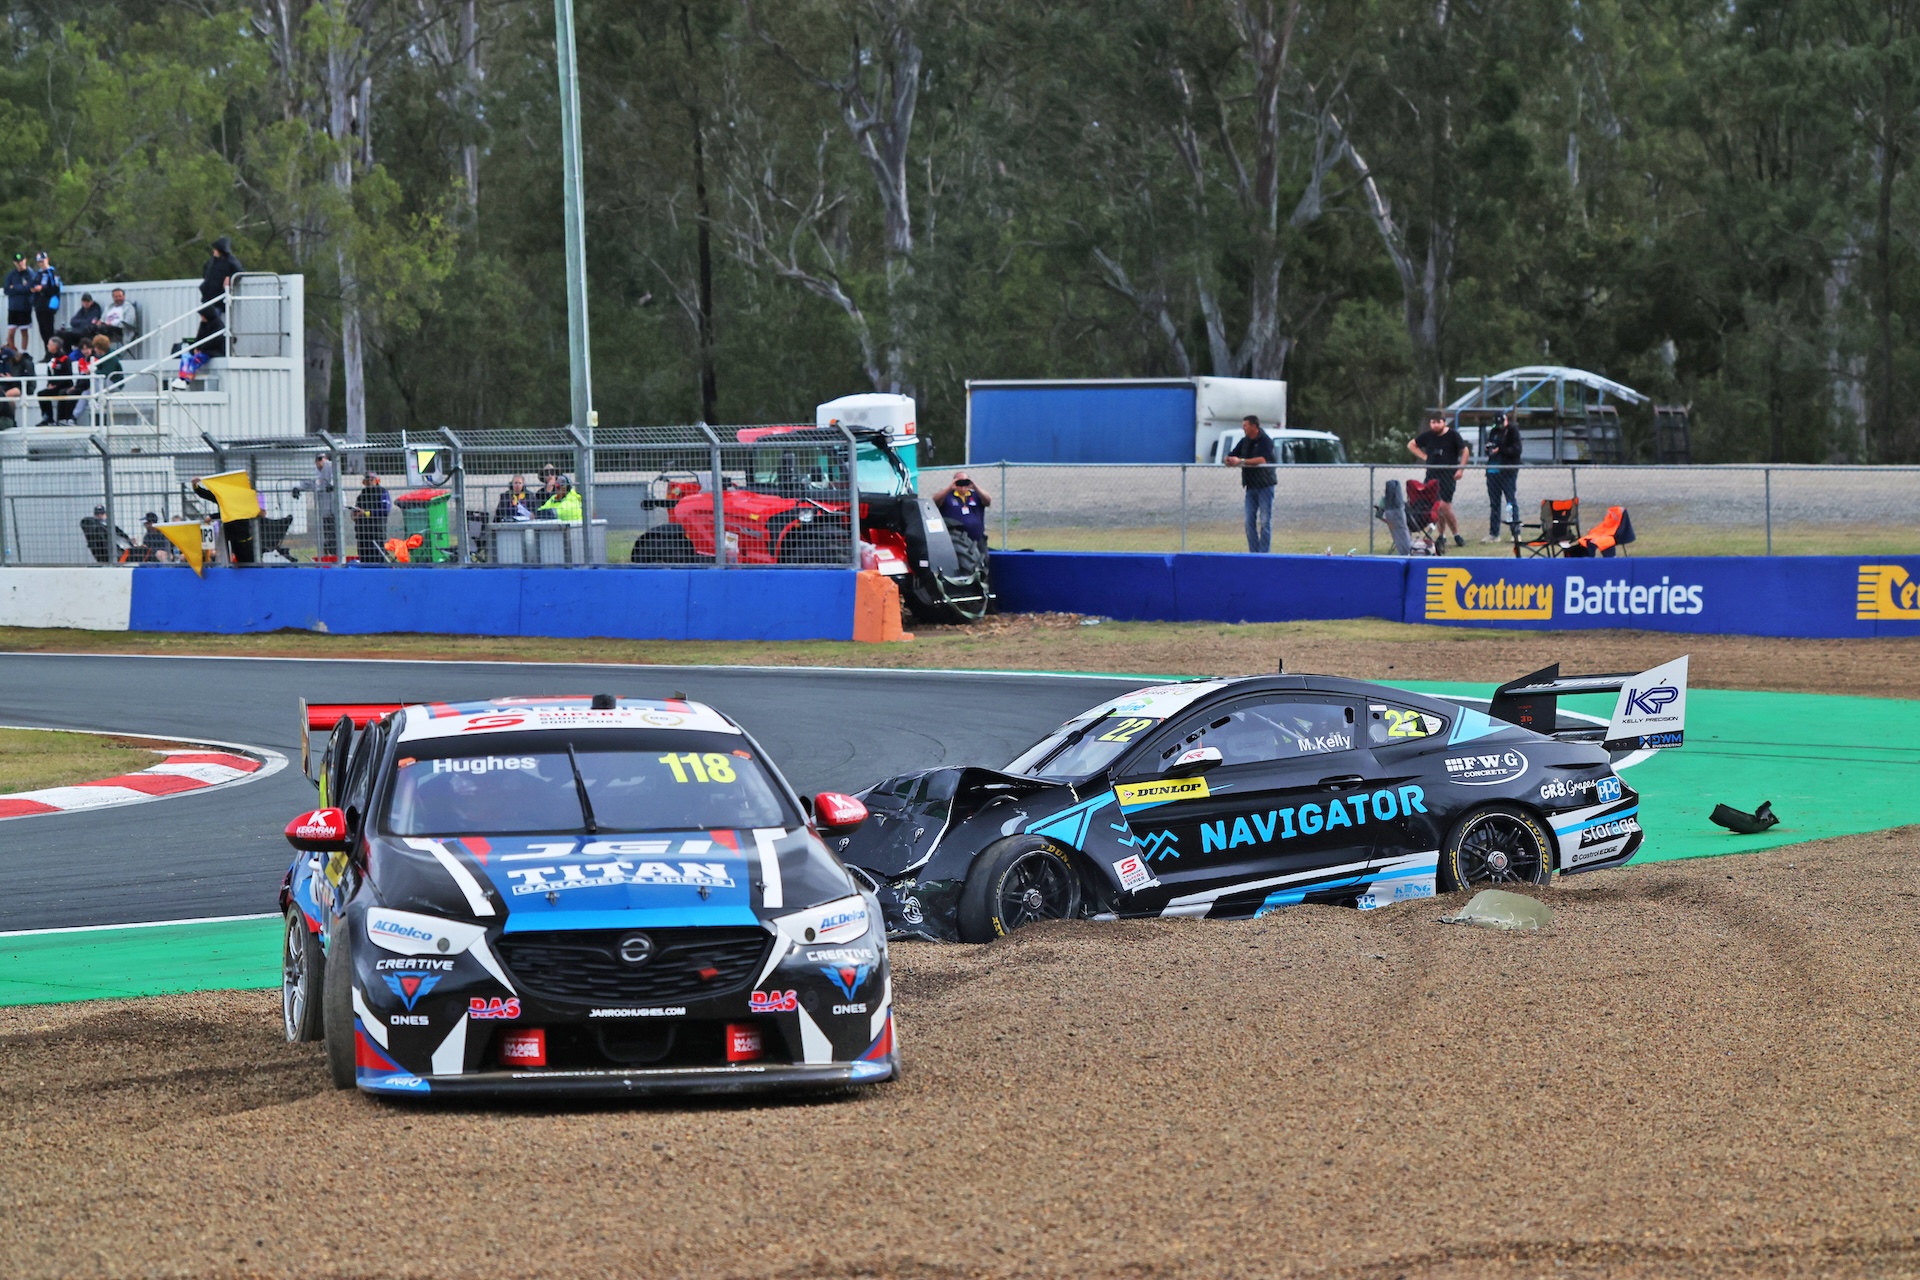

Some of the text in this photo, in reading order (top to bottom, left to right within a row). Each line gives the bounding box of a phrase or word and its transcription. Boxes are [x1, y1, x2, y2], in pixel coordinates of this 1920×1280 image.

[201, 528, 214, 543] P3
[1425, 567, 1704, 621] Century Batteries
[1856, 565, 1920, 620] Ce
[1097, 718, 1153, 742] 22
[1384, 709, 1426, 737] 22
[1651, 732, 1682, 745] DWM
[432, 755, 537, 775] Hughes
[658, 752, 738, 784] 118
[1463, 768, 1508, 778] CONCRETE
[1136, 782, 1202, 798] DUNLOP
[1540, 779, 1599, 800] GR8 Grapes
[1200, 785, 1428, 854] NAVIGATOR
[296, 825, 337, 835] KEIGHRAN
[1582, 817, 1638, 843] storage
[500, 839, 713, 862] JGI
[1578, 846, 1618, 860] Castrol EDGE
[507, 862, 726, 885] TITAN
[516, 876, 624, 894] GARAGES
[652, 877, 726, 886] SHEDS
[820, 910, 866, 930] ACDelco
[373, 920, 433, 941] ACDelco
[375, 958, 455, 971] CREATIVE
[806, 948, 875, 962] CREATIVE
[589, 1006, 687, 1018] JARRODHUGHES.COM
[832, 1002, 867, 1015] ONES
[390, 1014, 430, 1026] ONES
